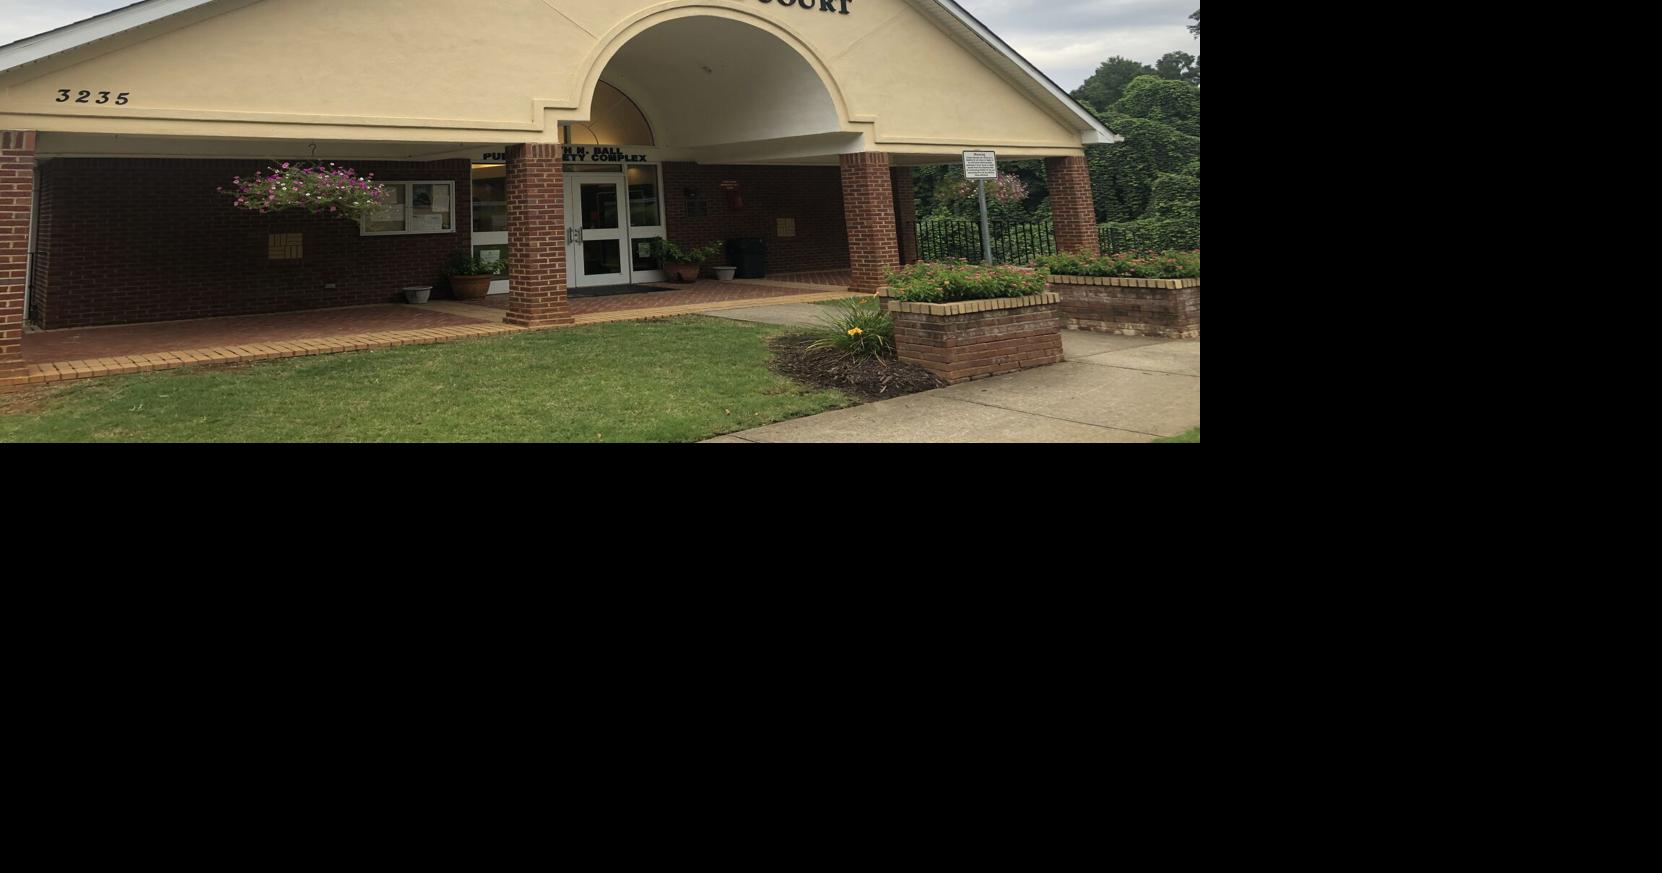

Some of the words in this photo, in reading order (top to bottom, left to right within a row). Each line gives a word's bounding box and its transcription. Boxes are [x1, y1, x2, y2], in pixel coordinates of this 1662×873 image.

[55, 88, 130, 105] 3235
[593, 147, 623, 155] BALL
[482, 152, 506, 161] PU
[562, 153, 585, 162] ETY
[591, 154, 647, 162] COMPLEX
